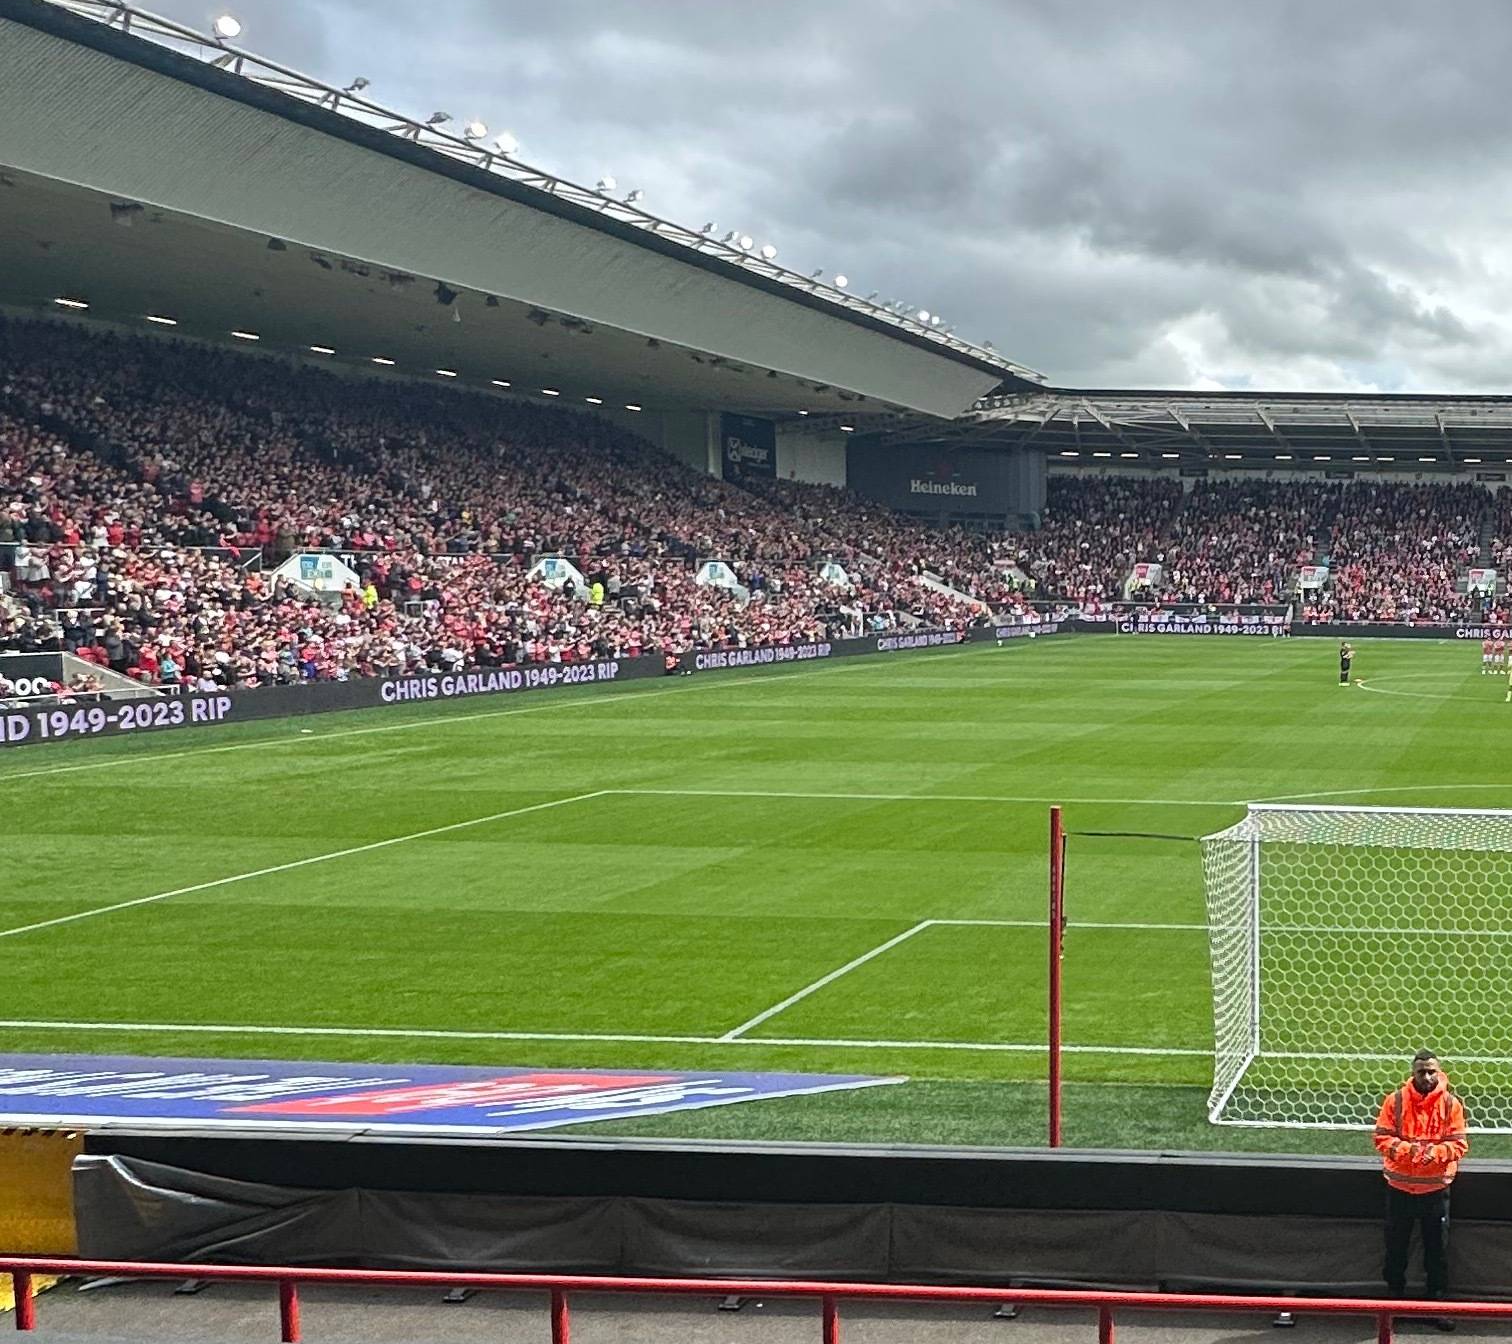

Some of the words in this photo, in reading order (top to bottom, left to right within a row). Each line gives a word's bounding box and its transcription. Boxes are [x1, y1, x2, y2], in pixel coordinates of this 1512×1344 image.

[910, 479, 977, 497] Heineken
[1157, 623, 1211, 634] GARLAND
[1213, 624, 1269, 635] 1949-2023
[1456, 628, 1491, 639] CHRIS
[695, 653, 727, 670] CHRIS
[728, 648, 773, 666] GARLAND
[775, 644, 817, 660] 1949-2023
[818, 643, 831, 656] RIP
[381, 677, 438, 702] CHRIS
[441, 670, 522, 696] GARLAND
[524, 666, 595, 688] 1949-2023
[598, 662, 619, 679] RIP
[37, 701, 185, 738] 1949-2023
[191, 696, 232, 722] RIP
